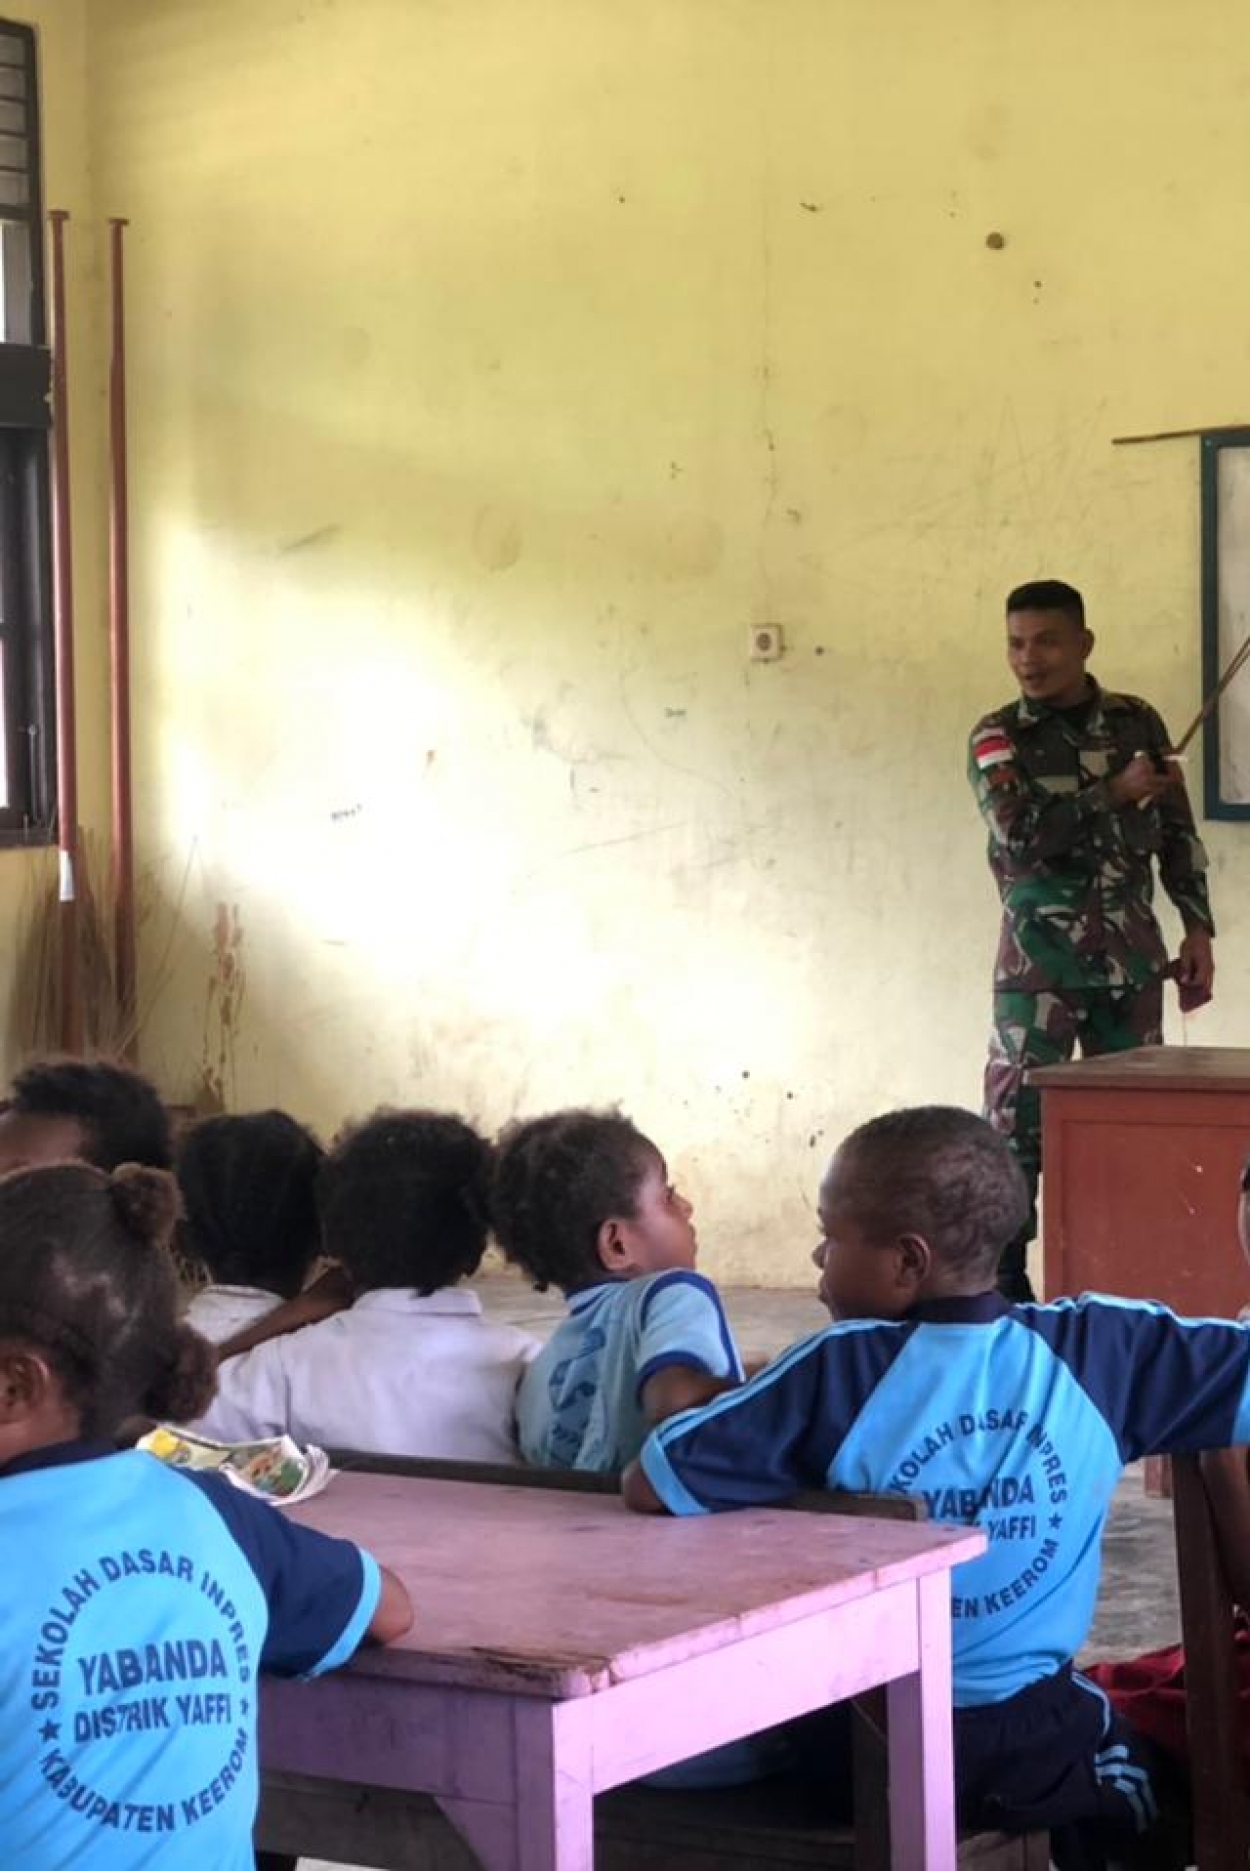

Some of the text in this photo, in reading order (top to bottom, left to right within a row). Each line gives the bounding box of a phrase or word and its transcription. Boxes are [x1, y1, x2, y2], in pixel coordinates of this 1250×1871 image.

[890, 1421, 954, 1494] KOLAH
[987, 1515, 1036, 1540] YAFFI
[984, 1538, 1059, 1615] KEEROM
[31, 1568, 100, 1710] SEKOLAH
[99, 1549, 193, 1583] DASAR
[78, 1638, 228, 1696] YABANDA
[74, 1693, 231, 1743] DISTRIK YAFFI
[39, 1727, 248, 1832] KABUPATEN KEEROM
